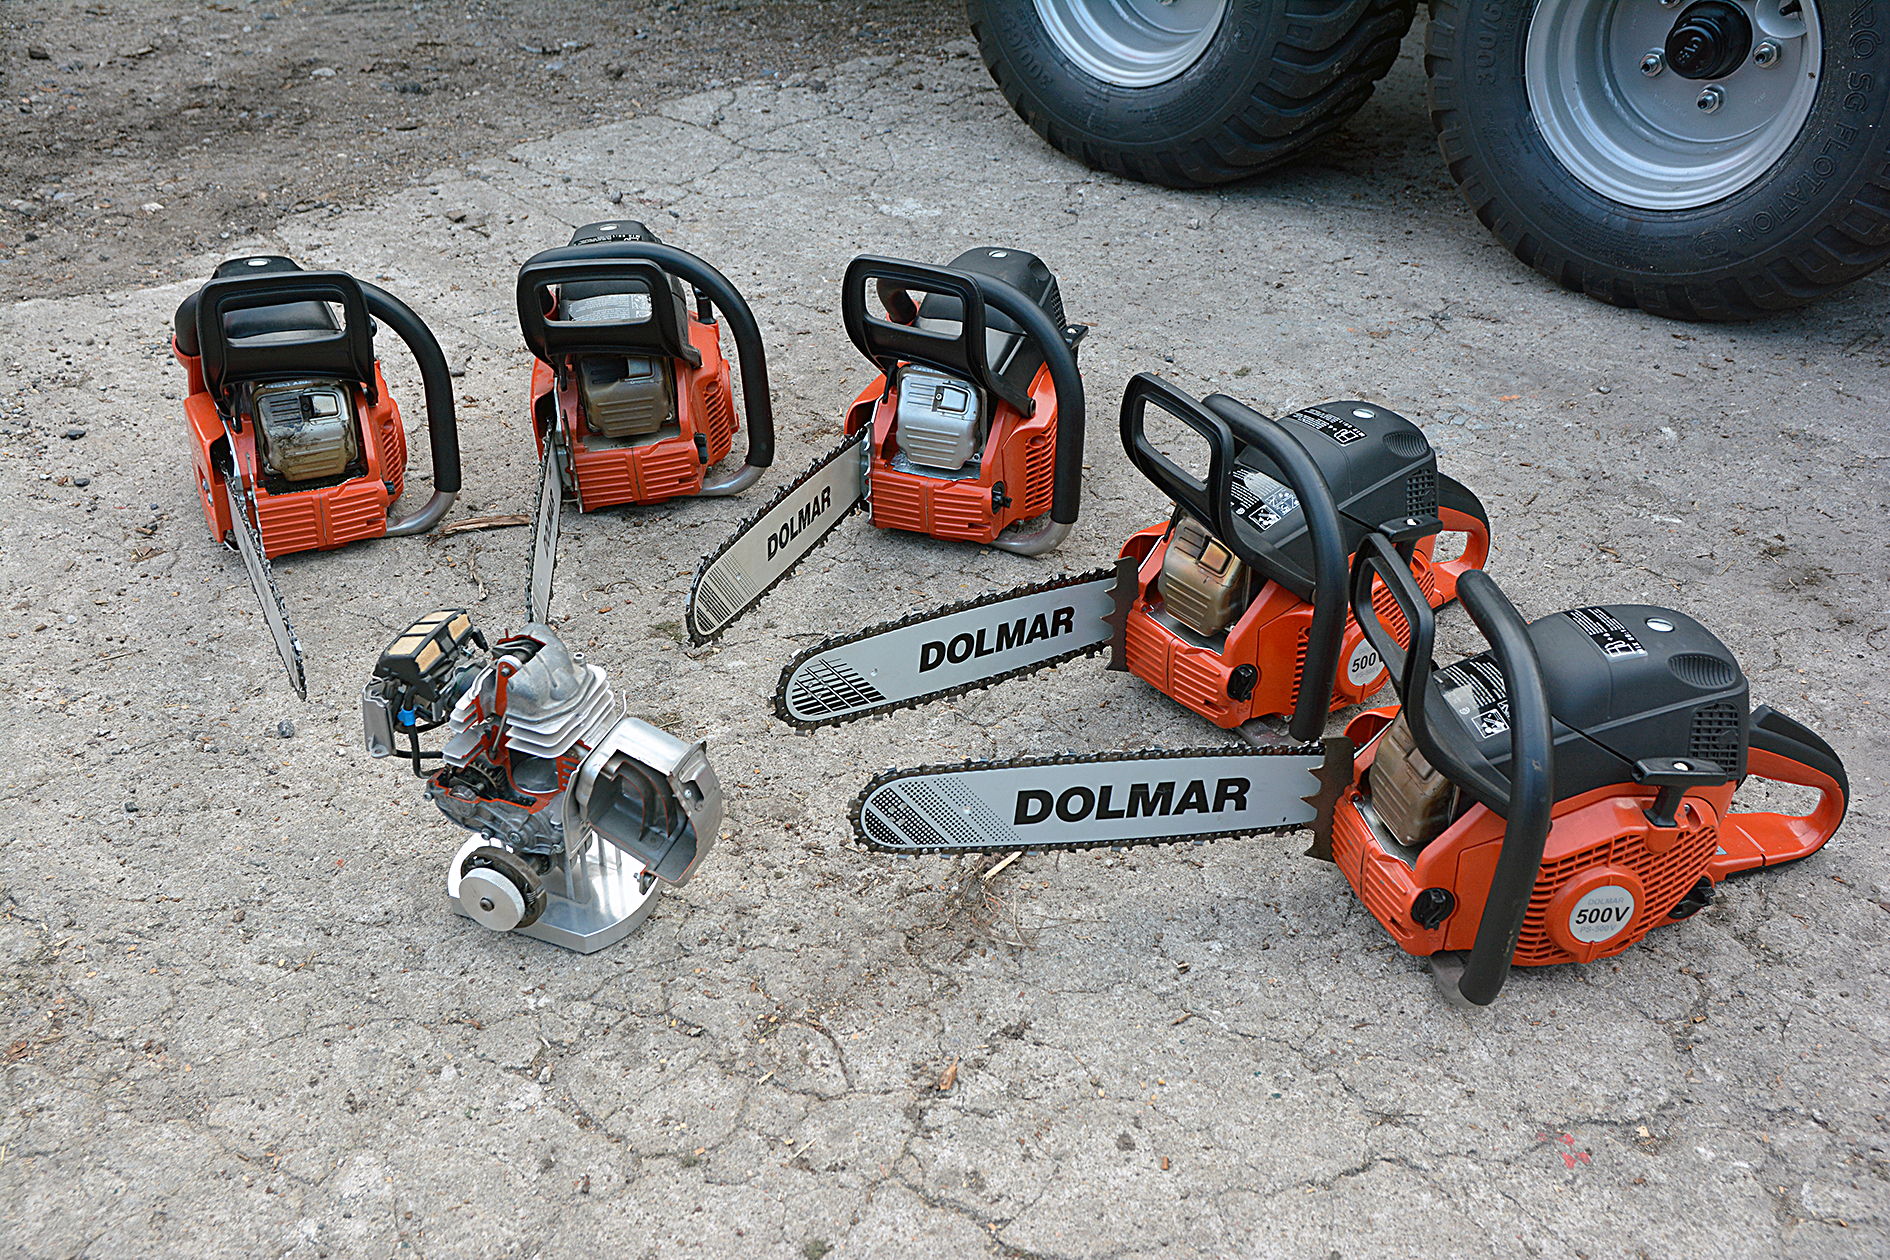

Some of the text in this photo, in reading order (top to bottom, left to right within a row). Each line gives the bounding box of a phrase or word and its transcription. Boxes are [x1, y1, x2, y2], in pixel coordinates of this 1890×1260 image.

[1476, 0, 1503, 86] 300/6
[1843, 71, 1875, 113] SG
[1733, 122, 1859, 245] FLOTATION
[767, 485, 832, 562] DOLMAR
[919, 606, 1075, 674] DOLMAR
[1352, 652, 1382, 673] 500
[1013, 777, 1251, 826] DOLMAR
[1575, 906, 1630, 924] 500V
[1588, 897, 1623, 905] DOLMAR
